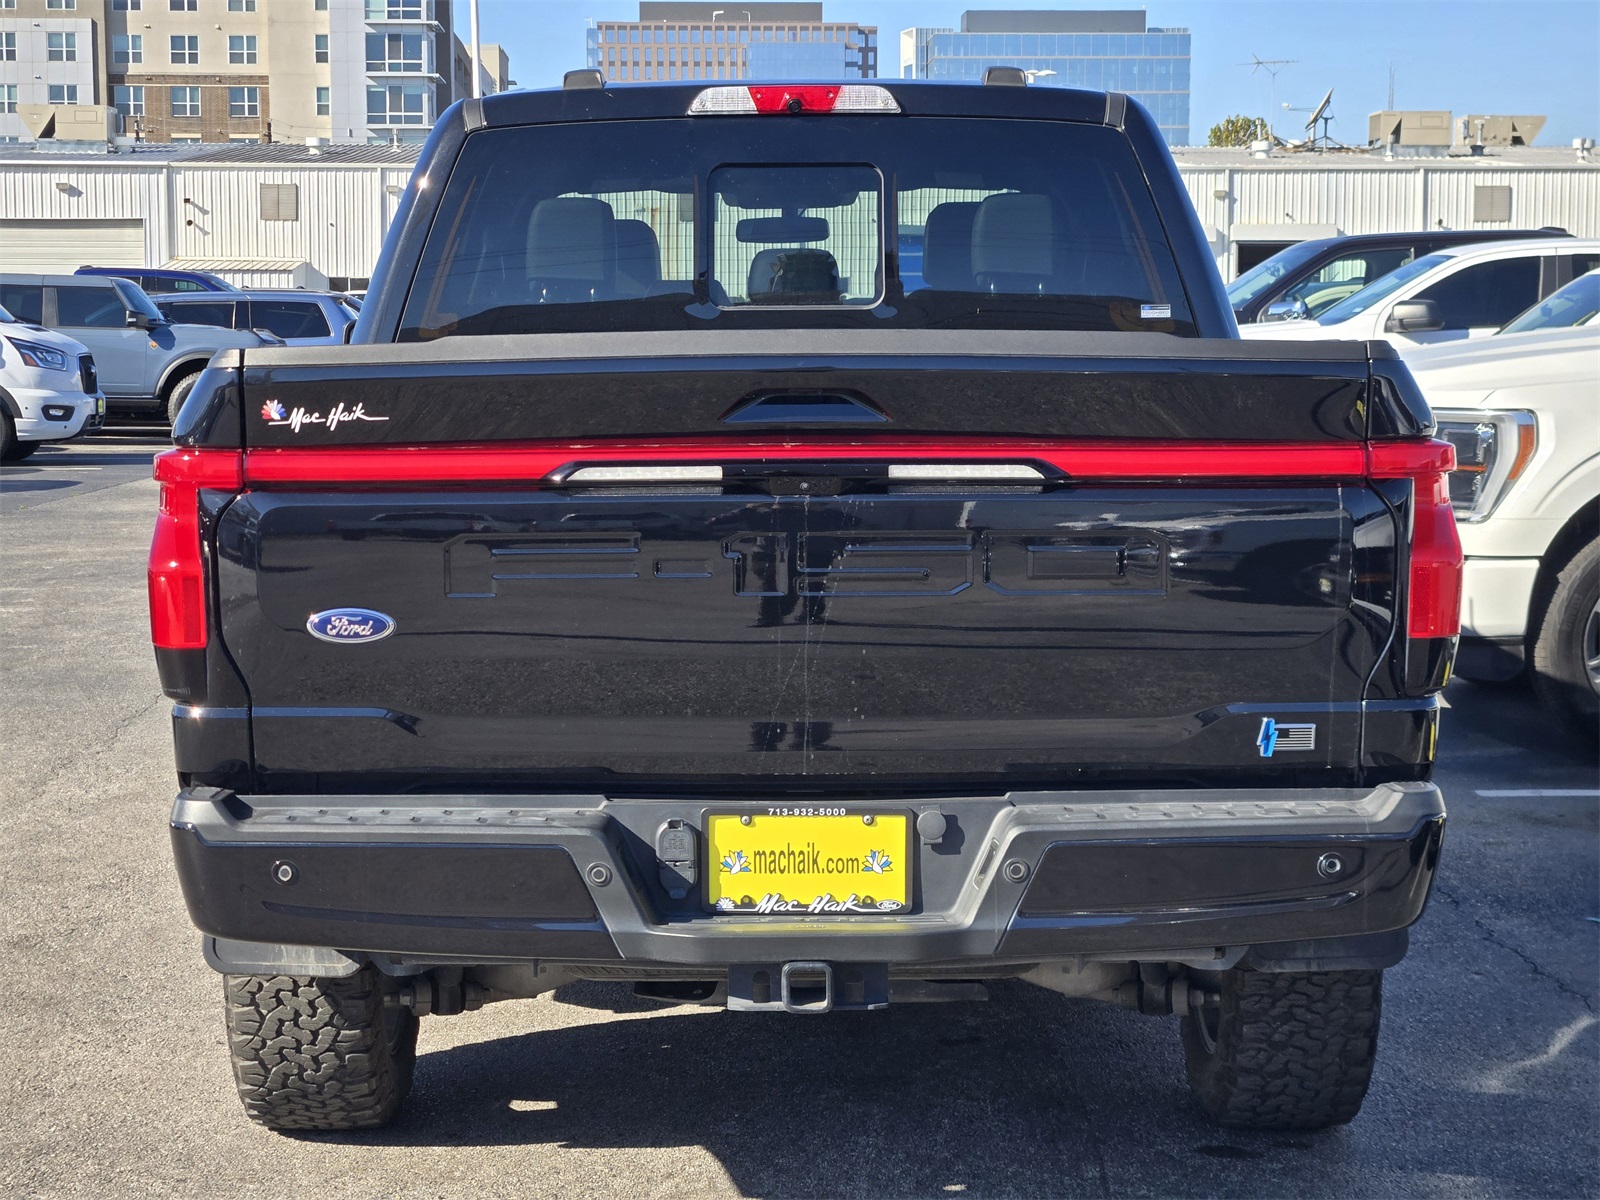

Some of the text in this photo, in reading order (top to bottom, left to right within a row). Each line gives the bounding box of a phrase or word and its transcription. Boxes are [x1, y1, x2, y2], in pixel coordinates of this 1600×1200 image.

[268, 402, 389, 433] Mac Haik
[444, 529, 1171, 597] F-150
[326, 616, 373, 636] Ford
[768, 808, 846, 816] 713-932-5000
[753, 842, 860, 874] machaik.com
[751, 893, 866, 913] Mac Haik
